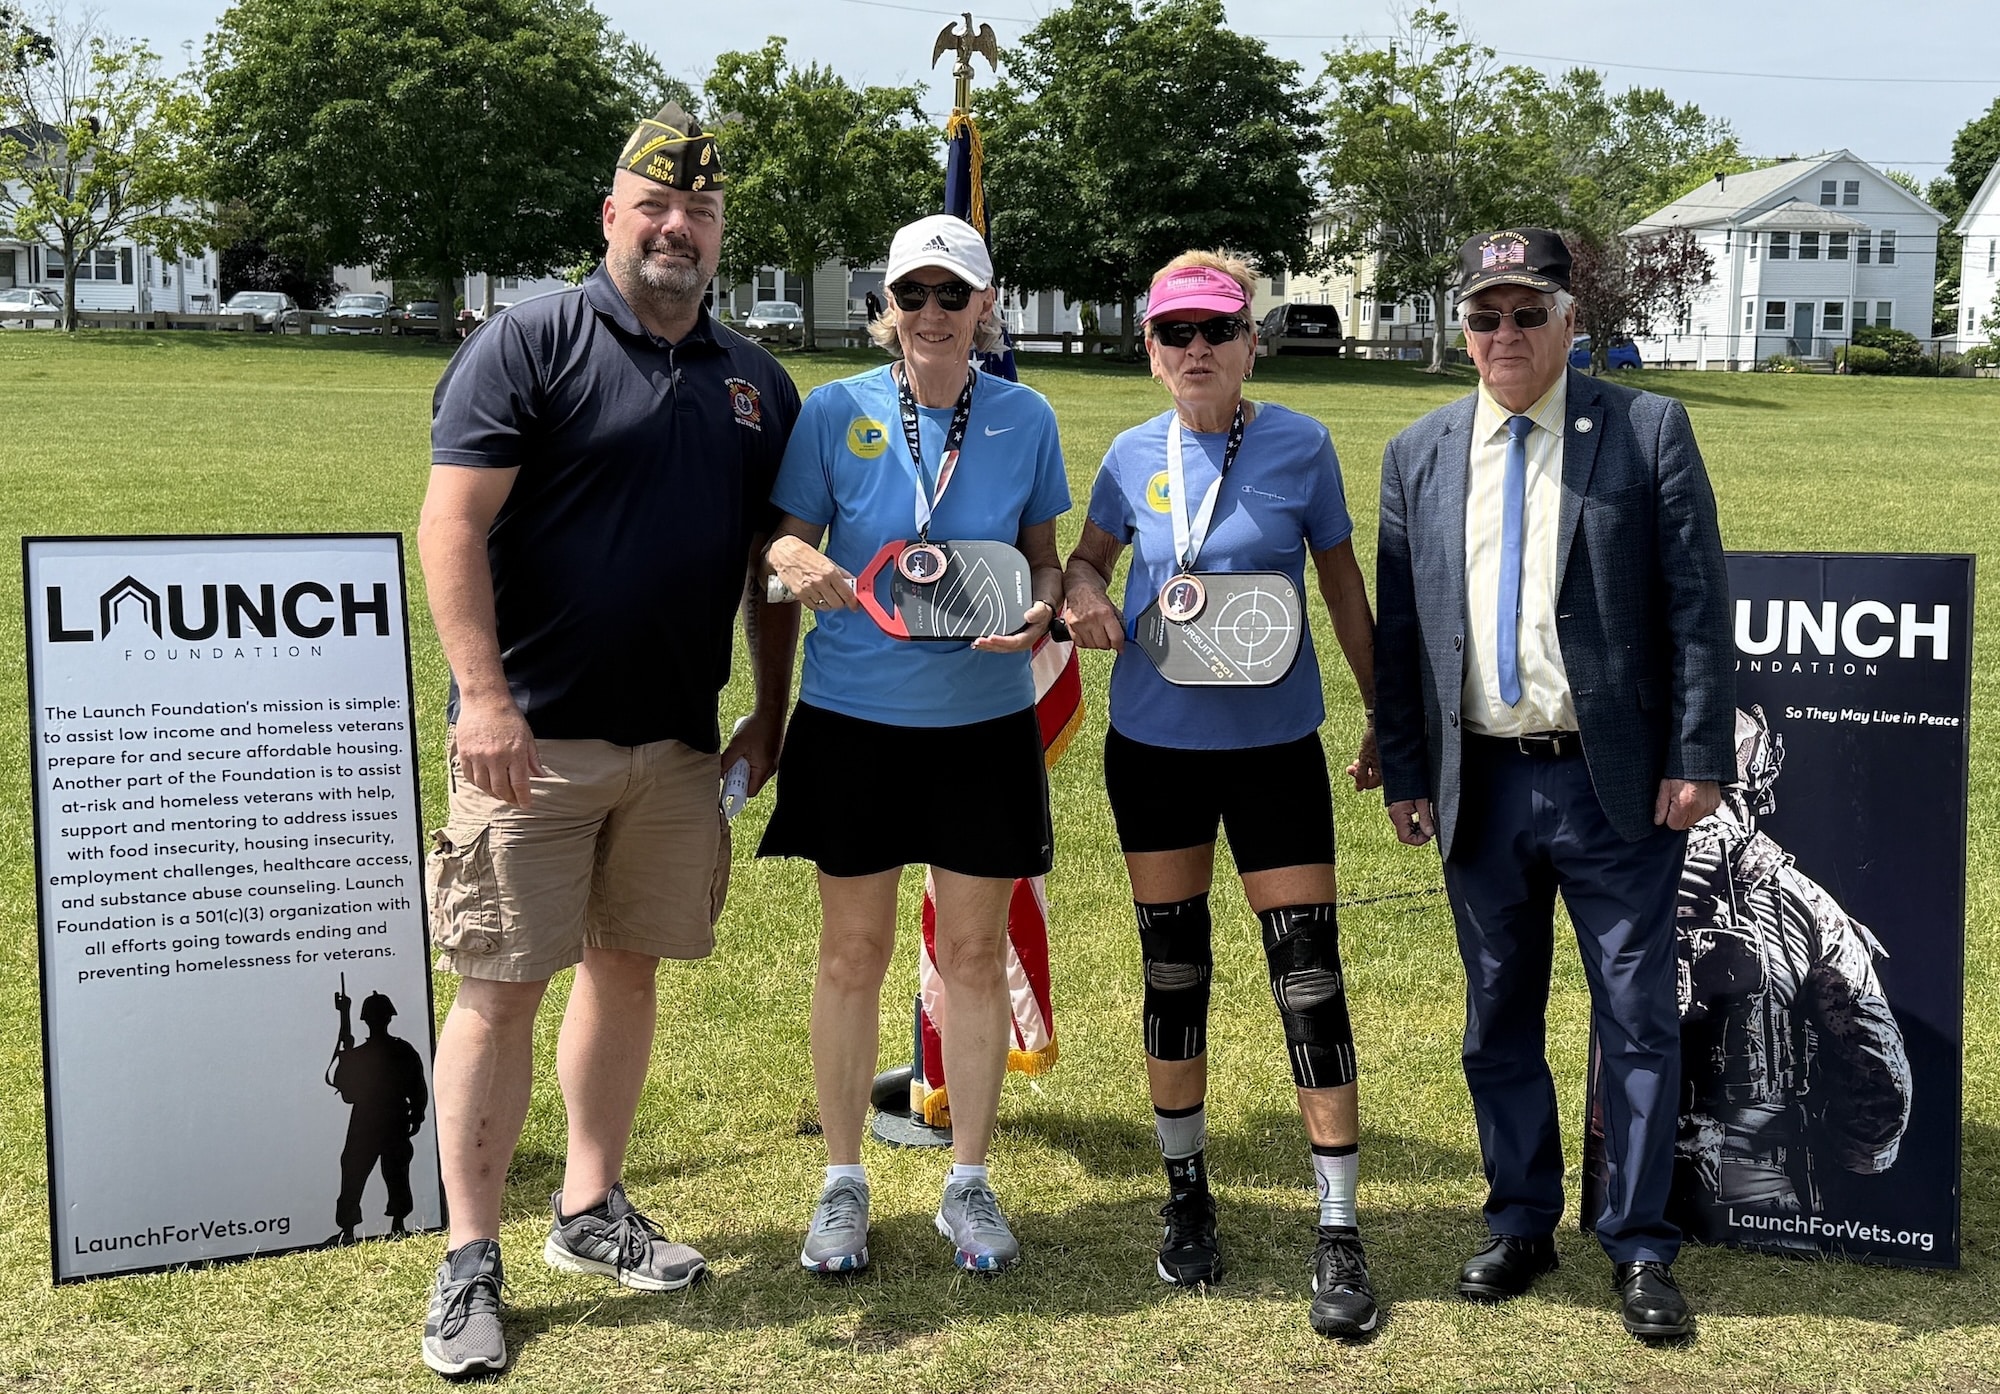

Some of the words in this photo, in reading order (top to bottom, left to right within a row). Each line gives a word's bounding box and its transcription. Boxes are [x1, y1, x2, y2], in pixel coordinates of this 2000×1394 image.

[646, 164, 674, 184] 10334
[653, 154, 674, 171] VFW
[854, 429, 882, 443] VP
[902, 412, 920, 458] PLACE
[46, 575, 390, 642] LAUNCH
[1734, 599, 1950, 661] UNCH
[125, 645, 322, 661] FOUNDATION
[1735, 660, 1878, 676] NDATION
[44, 706, 77, 720] The
[83, 704, 145, 719] Launch
[151, 700, 258, 716] Foundation's
[263, 699, 323, 712] mission
[328, 698, 340, 710] is
[345, 696, 400, 712] simple:
[1785, 706, 1803, 719] So
[1805, 707, 1838, 723] They
[1840, 708, 1870, 724] May
[1872, 710, 1901, 724] Live
[1902, 712, 1916, 724] in
[1918, 712, 1960, 727] Peace
[43, 732, 61, 744] to
[66, 729, 114, 743] assist
[119, 727, 148, 741] low
[153, 726, 215, 739] income
[220, 722, 251, 736] and
[257, 721, 333, 735] homeless
[337, 720, 404, 732] veterans
[48, 755, 115, 770] prepare
[121, 750, 145, 764] for
[149, 748, 182, 762] and
[187, 749, 241, 761] secure
[246, 742, 332, 758] affordable
[337, 741, 403, 756] housing.
[52, 775, 122, 791] Another
[127, 773, 163, 790] part
[168, 771, 185, 785] of
[189, 770, 216, 784] the
[222, 767, 316, 782] Foundation
[321, 765, 333, 778] is
[337, 765, 353, 777] to
[358, 763, 401, 776] assist
[62, 798, 117, 814] at-risk
[122, 796, 154, 810] and
[160, 793, 239, 808] homeless
[243, 791, 313, 804] veterans
[318, 787, 352, 800] with
[357, 785, 395, 801] help,
[61, 822, 128, 840] support
[133, 818, 165, 833] and
[171, 815, 257, 831] mentoring
[262, 814, 278, 826] to
[284, 811, 347, 825] address
[352, 809, 398, 822] issues
[67, 846, 104, 861] with
[109, 843, 148, 858] food
[154, 839, 239, 856] insecurity,
[244, 835, 309, 851] housing
[314, 831, 394, 846] insecurity,
[50, 867, 158, 887] employment
[163, 863, 258, 878] challenges,
[263, 857, 351, 872] healthcare
[356, 855, 412, 867] access,
[61, 893, 94, 909] and
[100, 892, 187, 906] substance
[192, 886, 242, 900] abuse
[248, 880, 340, 897] counseling.
[346, 874, 404, 890] Launch
[57, 915, 156, 934] Foundation
[161, 913, 174, 926] is
[179, 915, 190, 925] a
[196, 906, 264, 924] 501(c)(3)
[269, 900, 372, 921] organization
[377, 896, 410, 911] with
[85, 941, 105, 956] all
[111, 938, 167, 954] efforts
[172, 935, 220, 953] going
[225, 928, 291, 945] towards
[296, 925, 351, 940] ending
[357, 921, 387, 935] and
[78, 962, 170, 984] preventing
[176, 955, 291, 973] homelessness
[296, 950, 319, 963] for
[323, 947, 396, 961] veterans.
[75, 1216, 291, 1254] LaunchForVets.org
[1728, 1207, 1934, 1252] LaunchForVets.org
